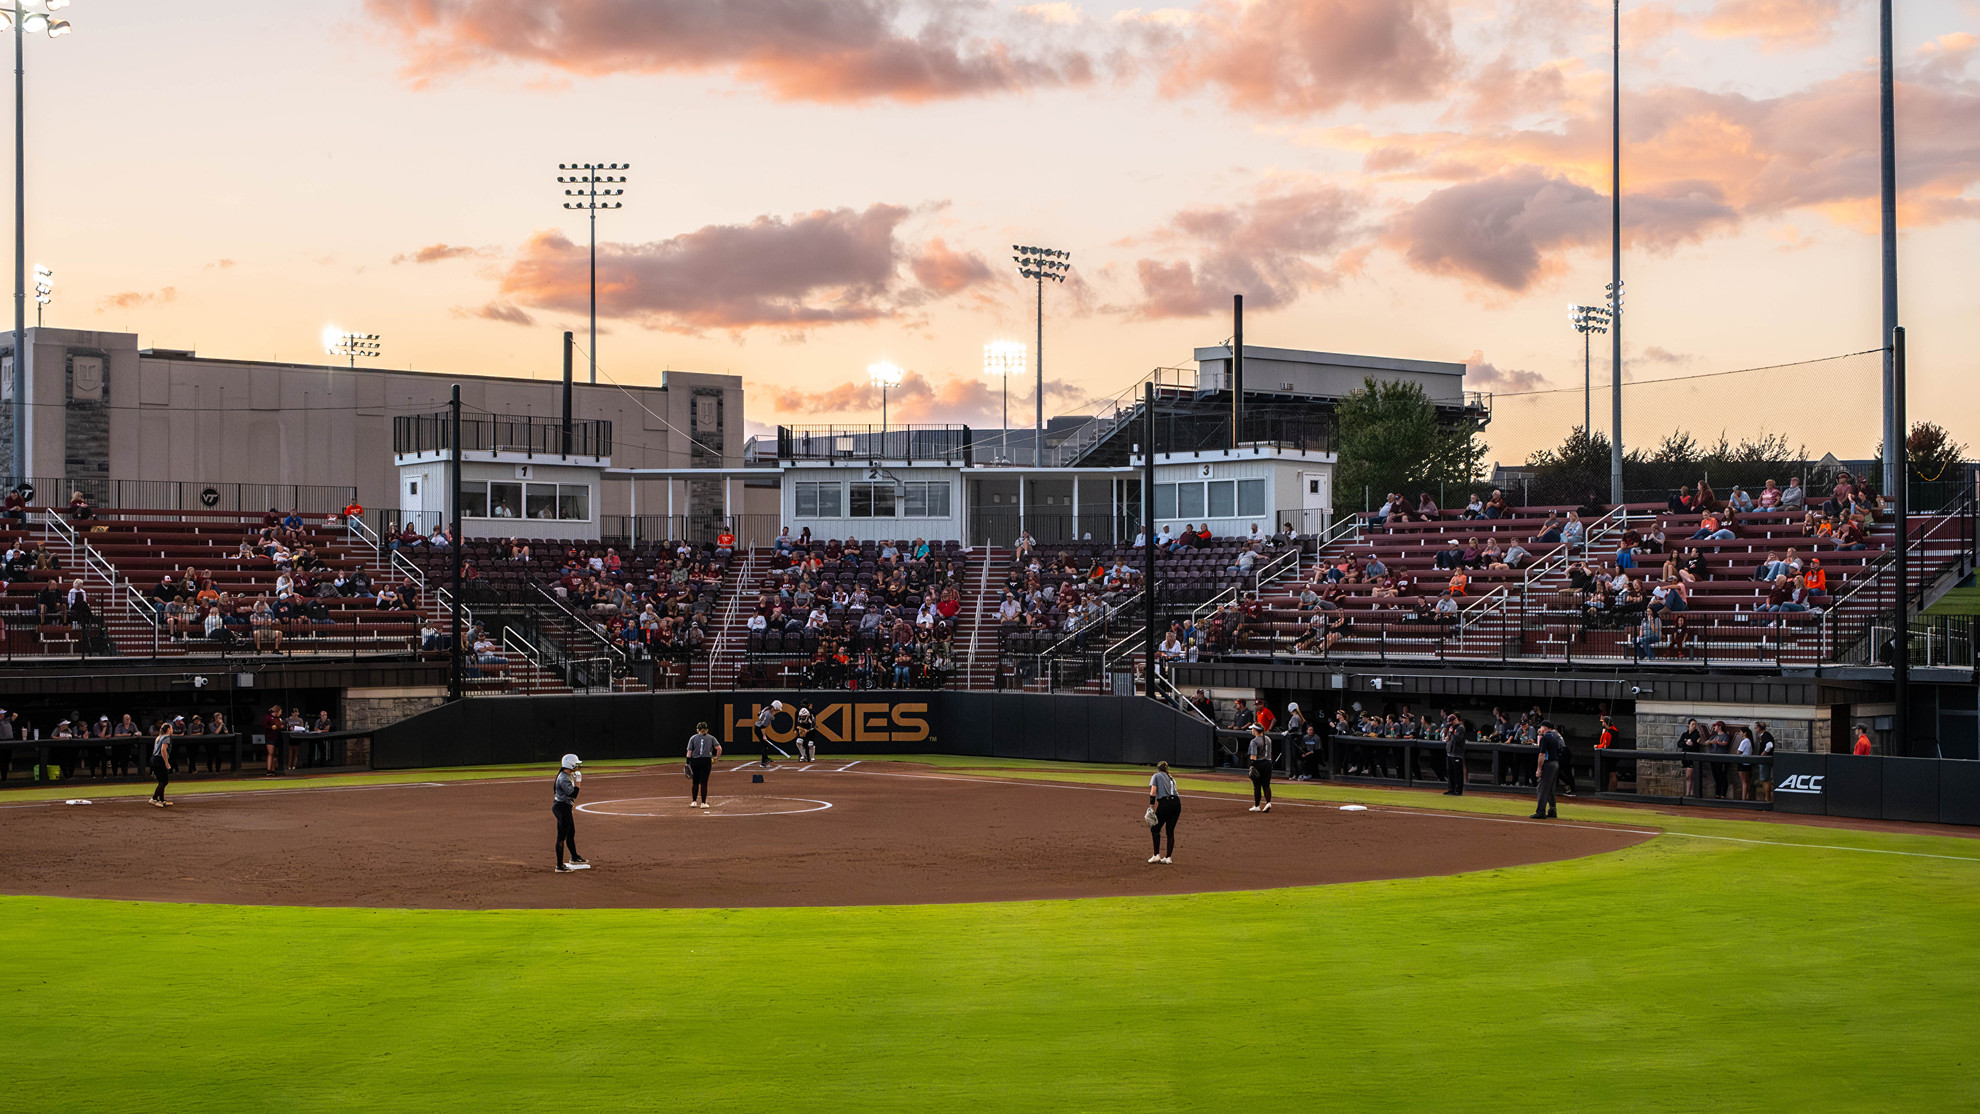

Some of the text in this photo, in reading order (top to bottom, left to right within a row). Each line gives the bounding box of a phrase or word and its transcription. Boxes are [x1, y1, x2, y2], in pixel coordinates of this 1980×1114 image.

[521, 466, 528, 477] 1
[868, 468, 877, 479] 2
[1203, 464, 1210, 476] 3
[203, 494, 218, 503] VT
[724, 703, 930, 743] HOKIES
[1778, 774, 1825, 790] ACC
